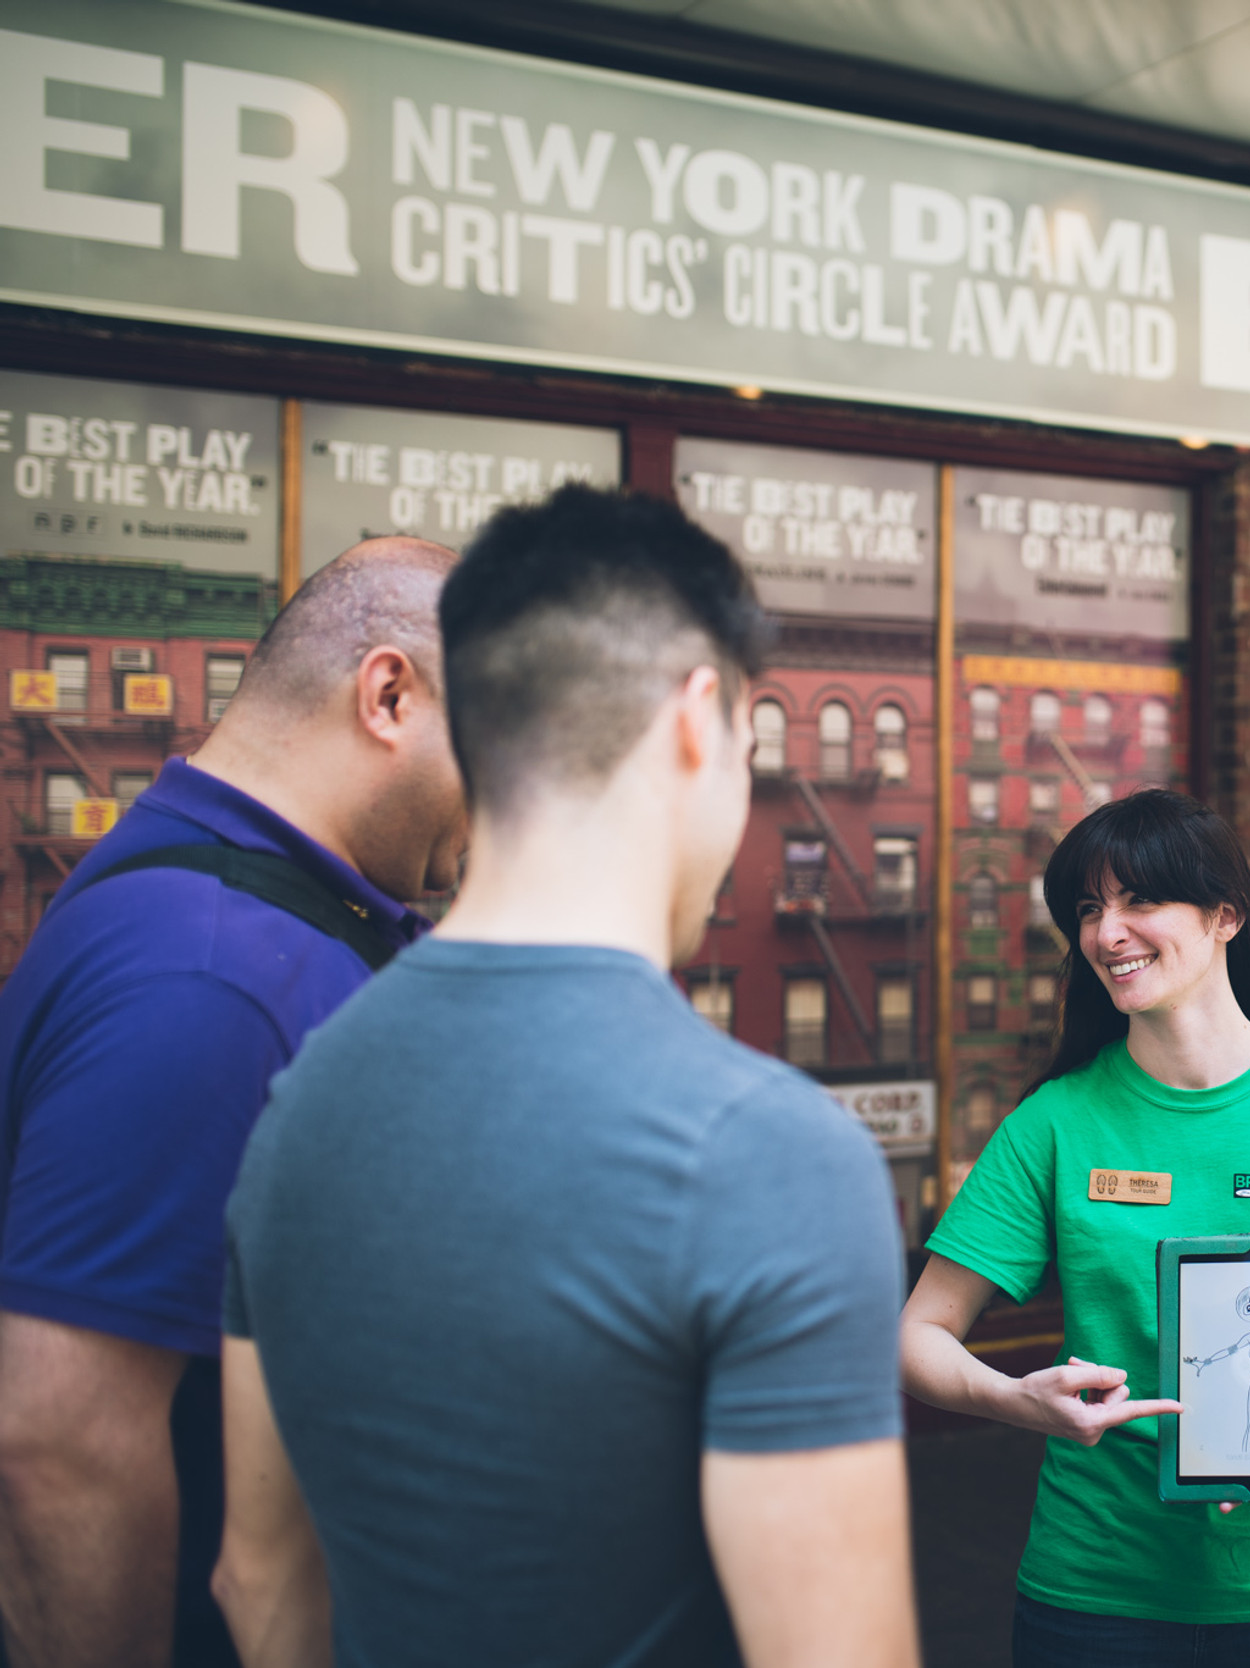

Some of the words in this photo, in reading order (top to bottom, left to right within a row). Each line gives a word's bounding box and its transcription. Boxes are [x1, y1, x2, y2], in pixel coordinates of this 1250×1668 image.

[390, 97, 615, 212] NEW
[633, 137, 866, 254] YORK
[889, 181, 1175, 299] DRAMA
[723, 243, 933, 351] CIRCLE
[946, 276, 1178, 381] AWARD
[26, 413, 138, 463] BEST
[147, 424, 252, 473] PLAY
[14, 456, 58, 500] OF
[66, 459, 149, 507] THE
[400, 446, 495, 491] BEST
[388, 486, 427, 528] OF
[752, 477, 836, 518] BEST
[838, 485, 919, 526] PLAY
[1028, 498, 1102, 541] BEST
[1104, 505, 1177, 546] PLAY
[780, 515, 843, 560] THE
[1053, 534, 1110, 576] THE
[1129, 1178, 1159, 1188] THERESA
